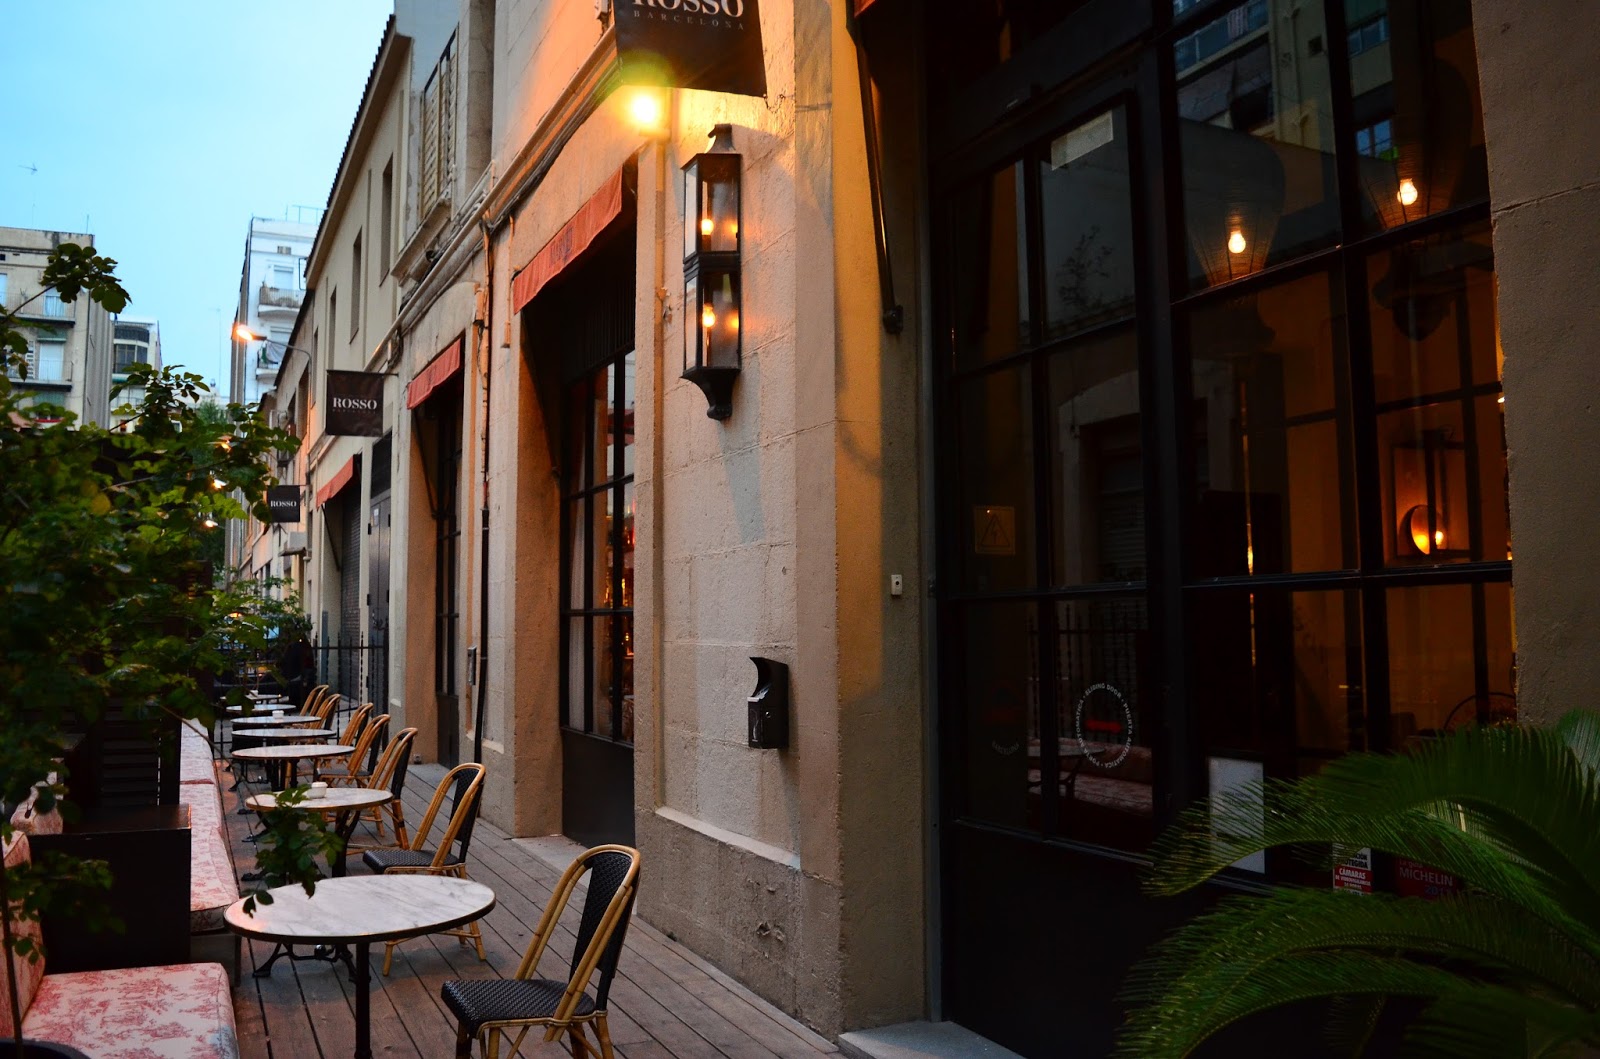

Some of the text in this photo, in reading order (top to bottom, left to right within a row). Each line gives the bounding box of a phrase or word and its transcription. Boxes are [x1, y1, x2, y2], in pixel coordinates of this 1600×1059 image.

[633, 0, 744, 18] SSO
[633, 10, 744, 30] BARCELONA
[332, 397, 378, 410] ROSSO
[270, 500, 297, 508] ROSSO
[1106, 684, 1122, 699] DOOR
[1399, 867, 1454, 887] MICHELIN
